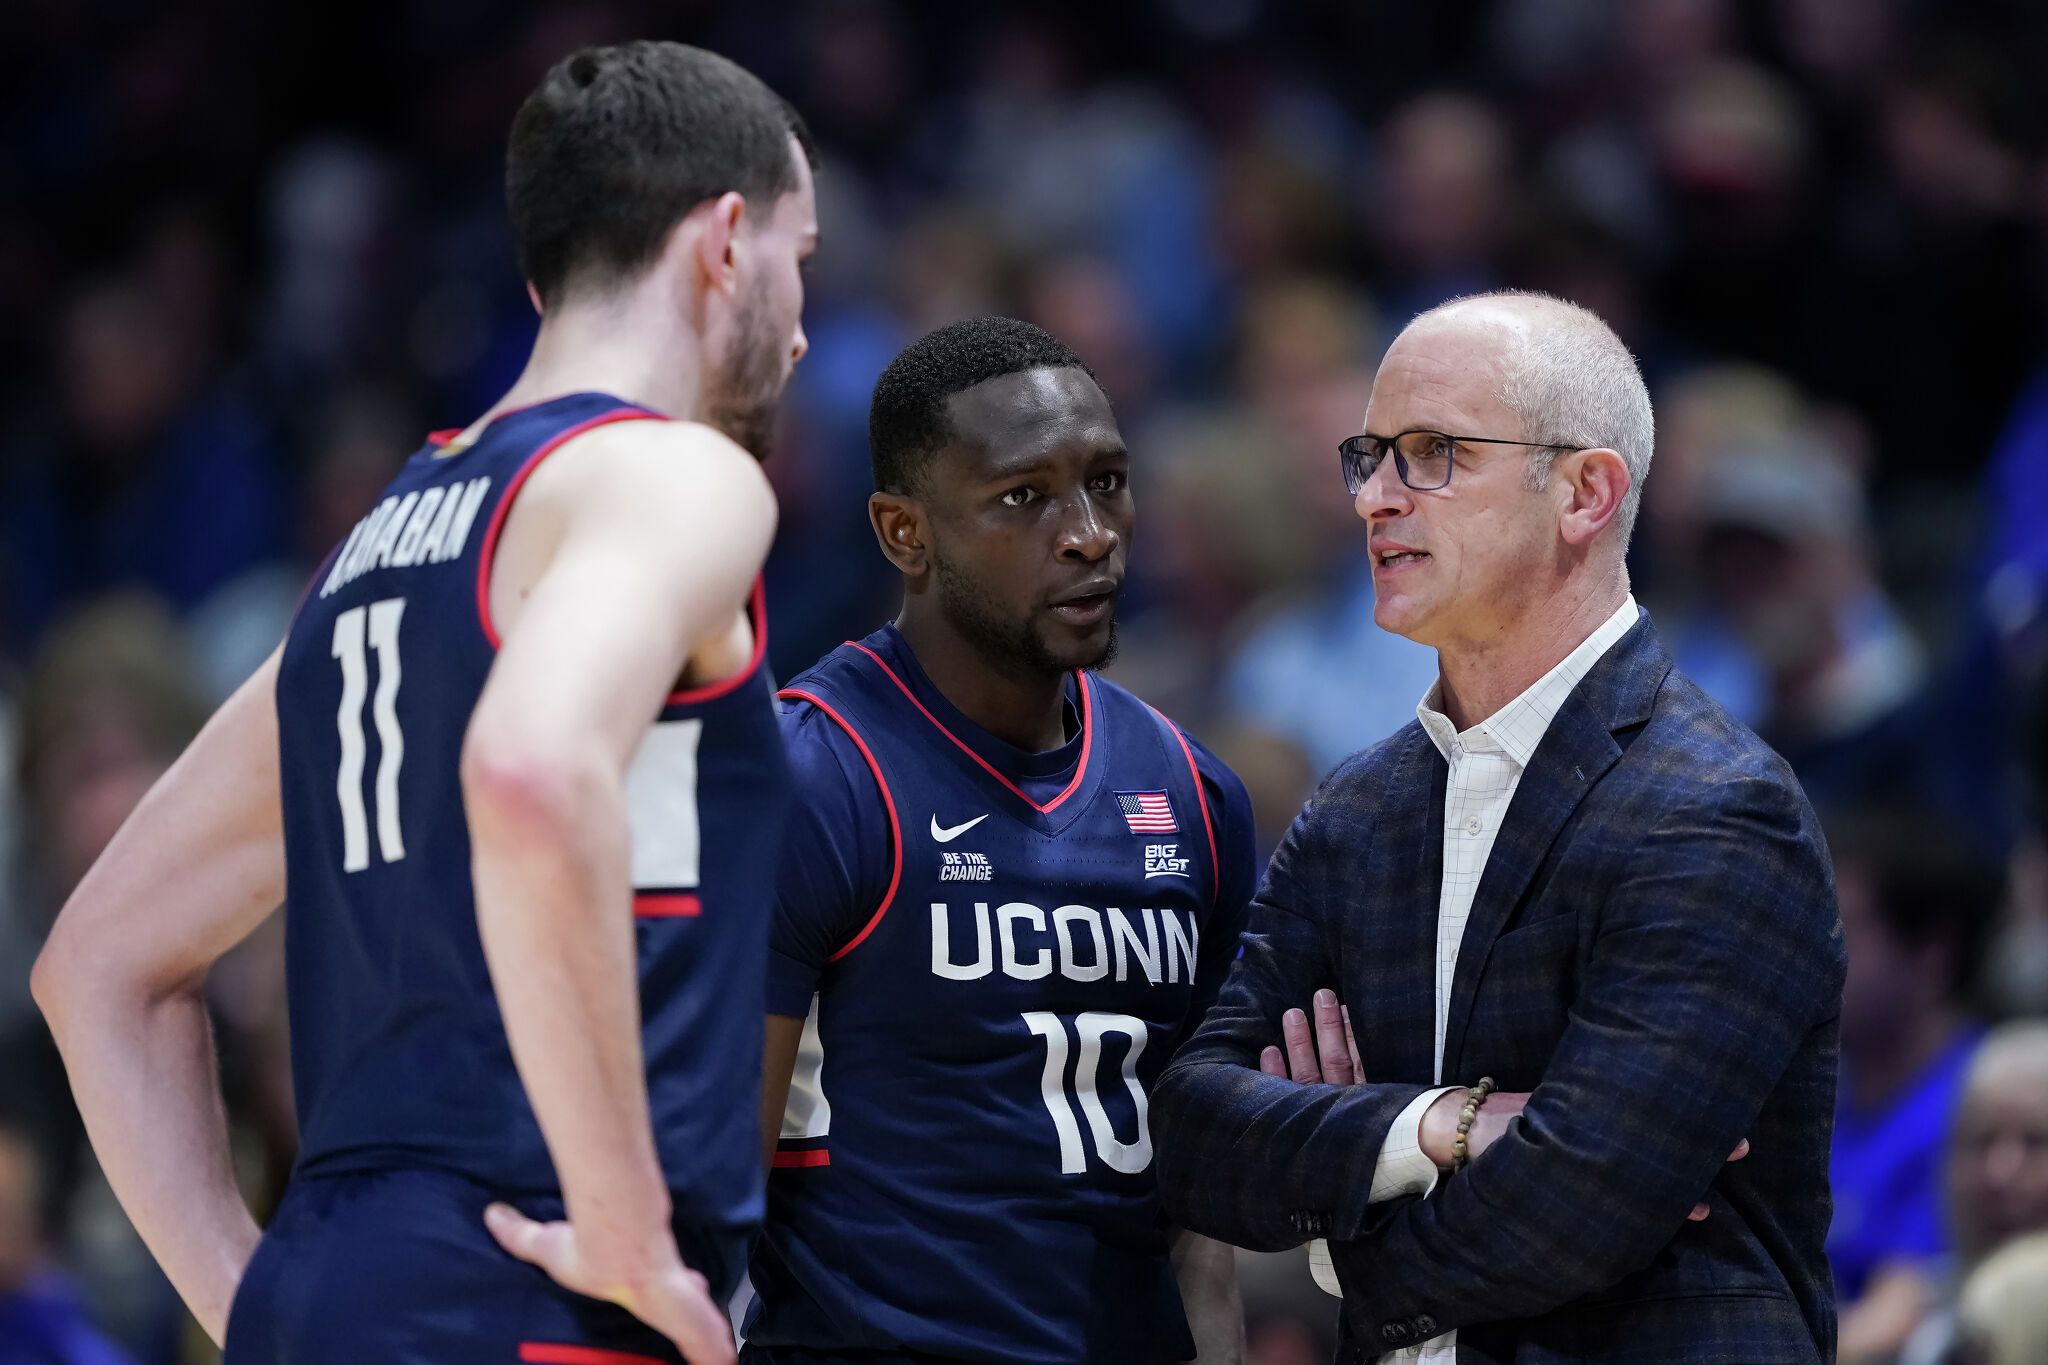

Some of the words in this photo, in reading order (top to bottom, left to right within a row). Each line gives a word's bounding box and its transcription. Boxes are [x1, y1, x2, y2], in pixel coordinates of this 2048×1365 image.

[331, 597, 407, 873] 11
[943, 852, 962, 865] BE
[961, 852, 988, 865] THE
[1145, 844, 1177, 858] BIG
[1145, 858, 1190, 871] EAST
[940, 865, 992, 881] CHANGE
[931, 902, 1199, 985] UCONN
[1021, 1011, 1153, 1174] 10
